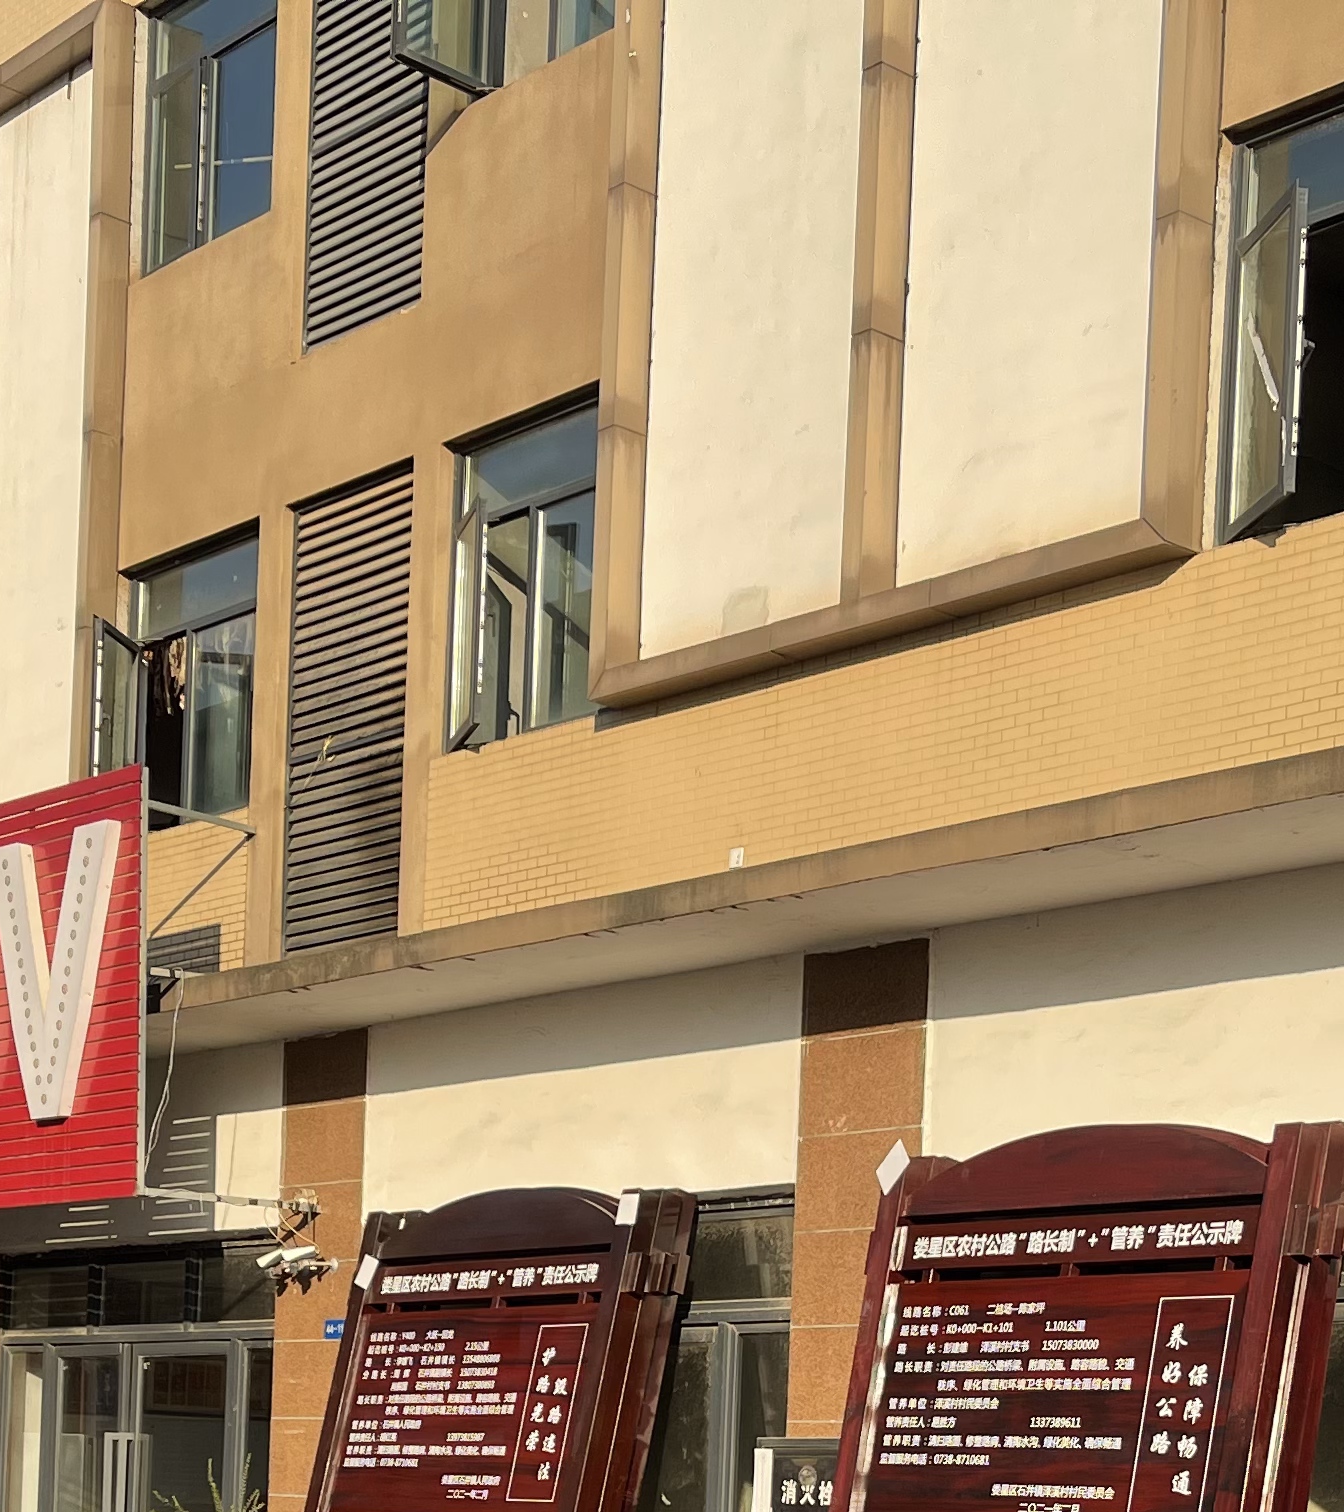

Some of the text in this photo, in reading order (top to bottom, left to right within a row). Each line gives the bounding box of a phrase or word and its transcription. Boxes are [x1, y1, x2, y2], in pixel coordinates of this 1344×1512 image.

[1149, 1322, 1189, 1456] 养好公路
[1170, 1363, 1209, 1496] 保障畅通
[780, 1478, 834, 1507] 消火栓
